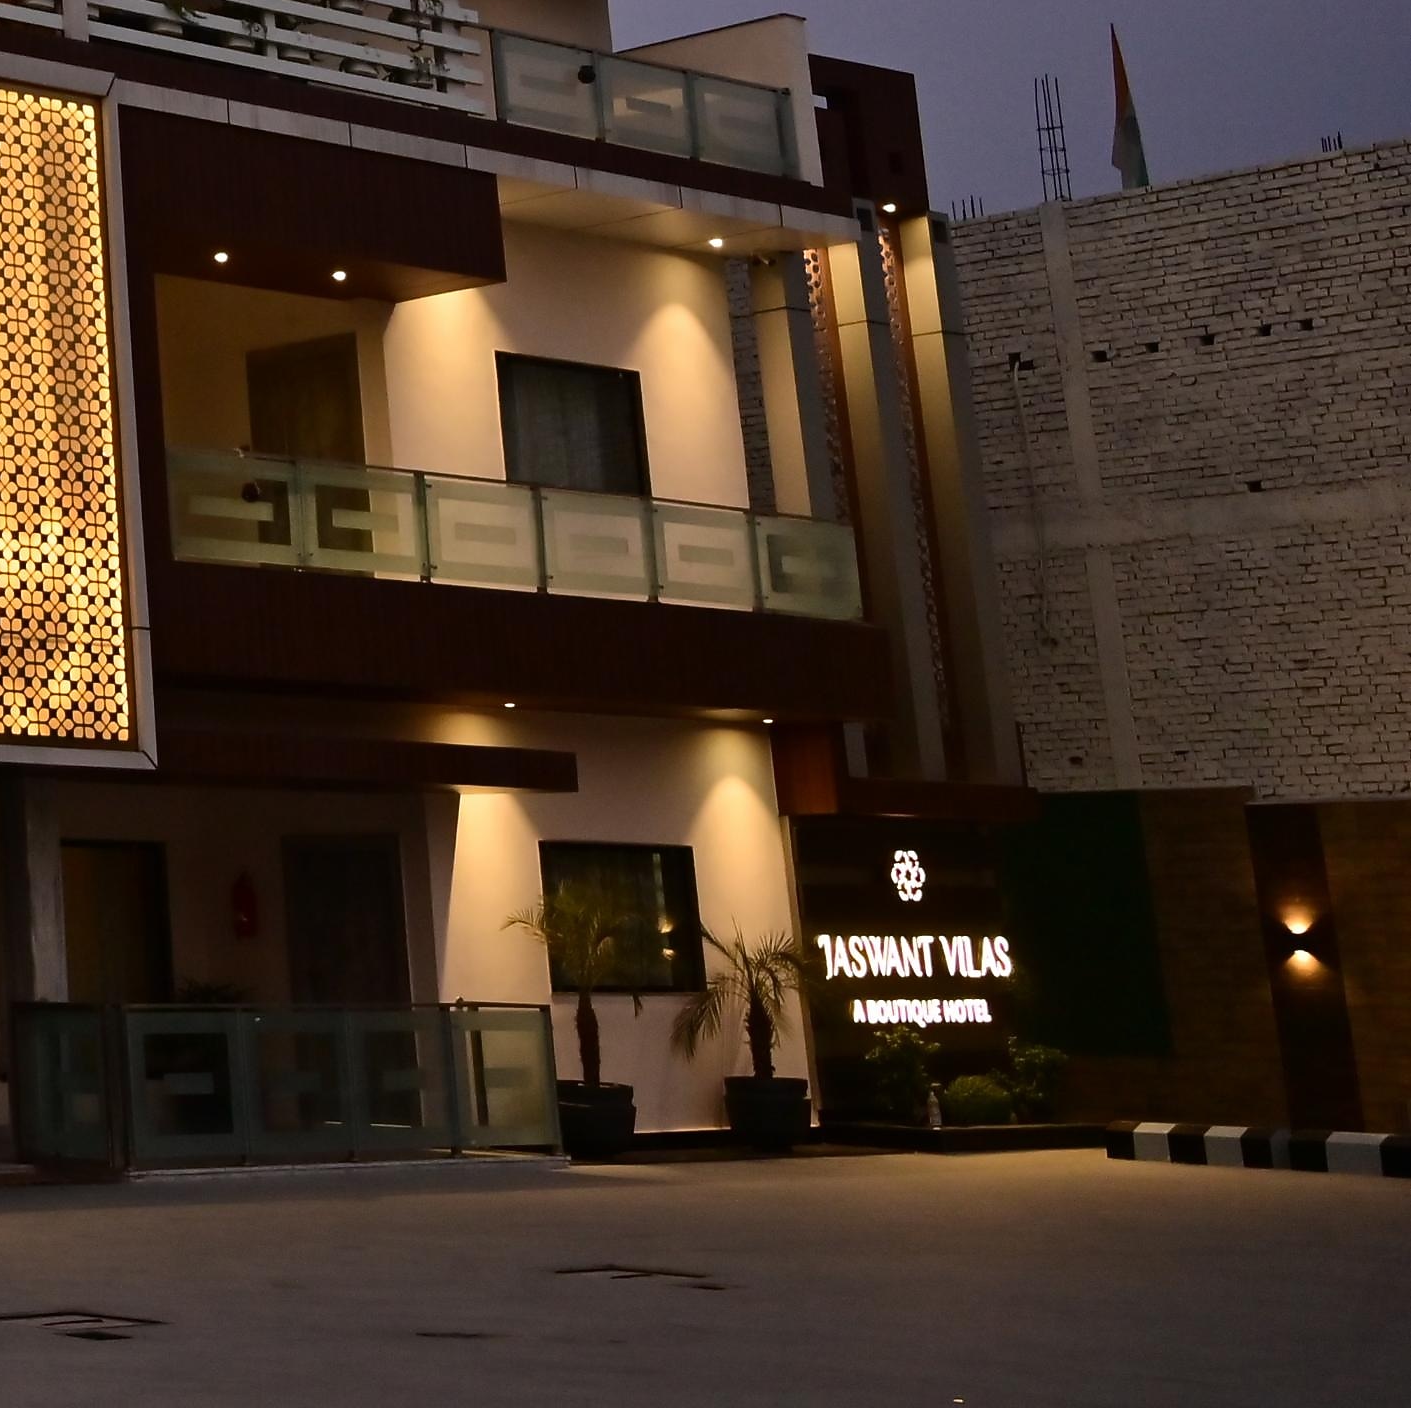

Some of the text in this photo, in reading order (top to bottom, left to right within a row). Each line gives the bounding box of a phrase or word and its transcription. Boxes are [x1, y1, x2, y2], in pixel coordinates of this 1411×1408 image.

[817, 934, 1013, 980] JASWANT VILAS
[853, 999, 993, 1029] A BOUTIQUE HOTEL
